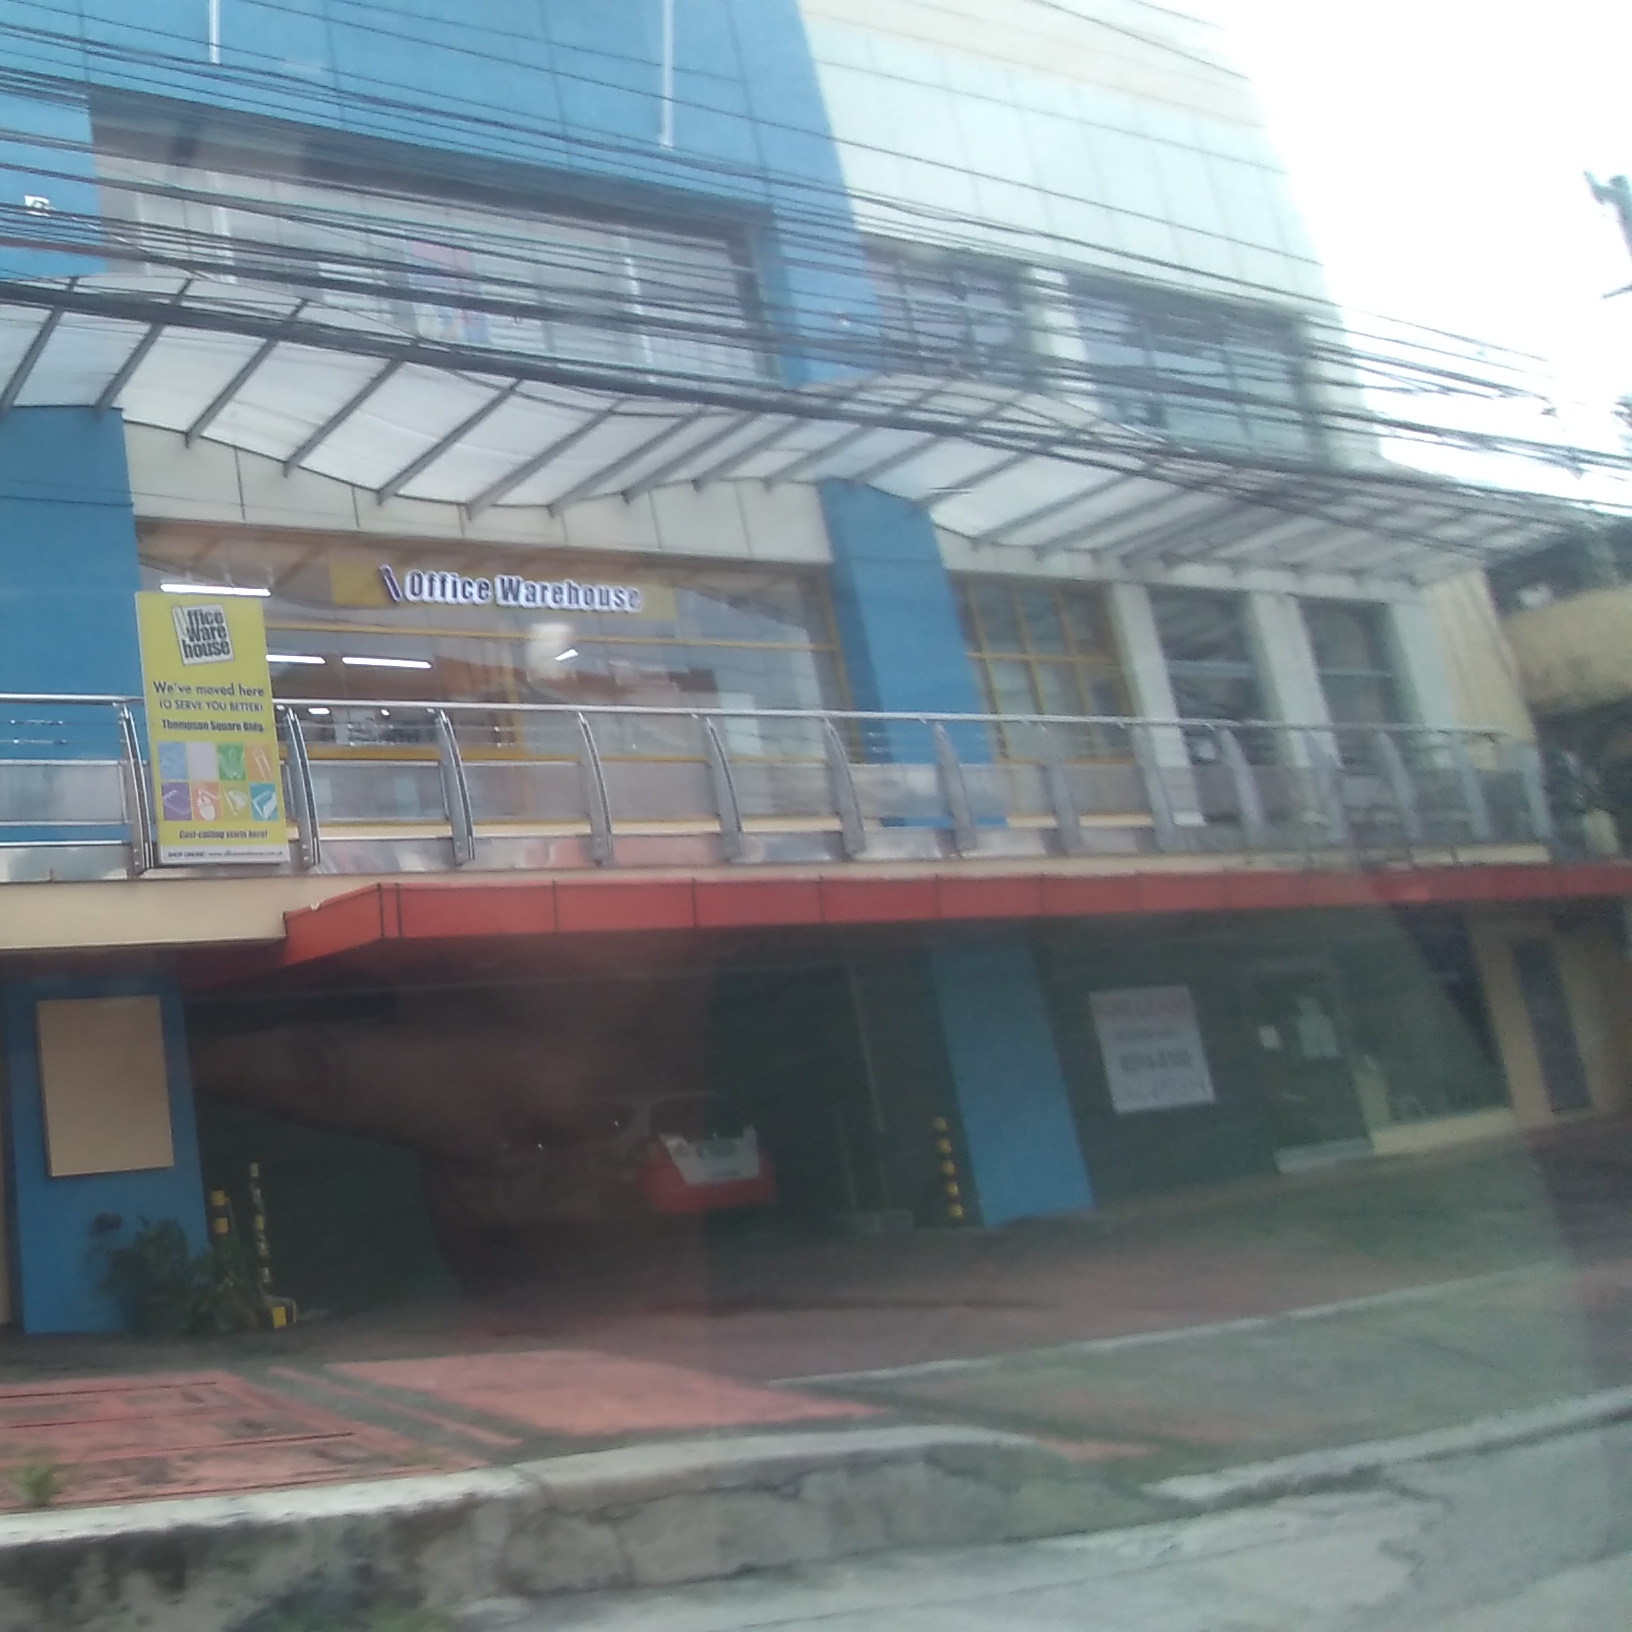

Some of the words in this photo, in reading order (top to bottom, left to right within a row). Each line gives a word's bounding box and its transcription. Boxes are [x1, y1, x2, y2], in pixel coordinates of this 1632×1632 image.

[406, 571, 491, 604] Office
[496, 575, 641, 612] Warehouse
[181, 639, 231, 658] house
[153, 681, 192, 694] We've
[196, 682, 235, 696] moved
[239, 683, 265, 696] here
[175, 700, 203, 710] SERVE
[206, 700, 227, 711] YOU
[162, 719, 209, 732] Thompson
[210, 720, 242, 732] Square
